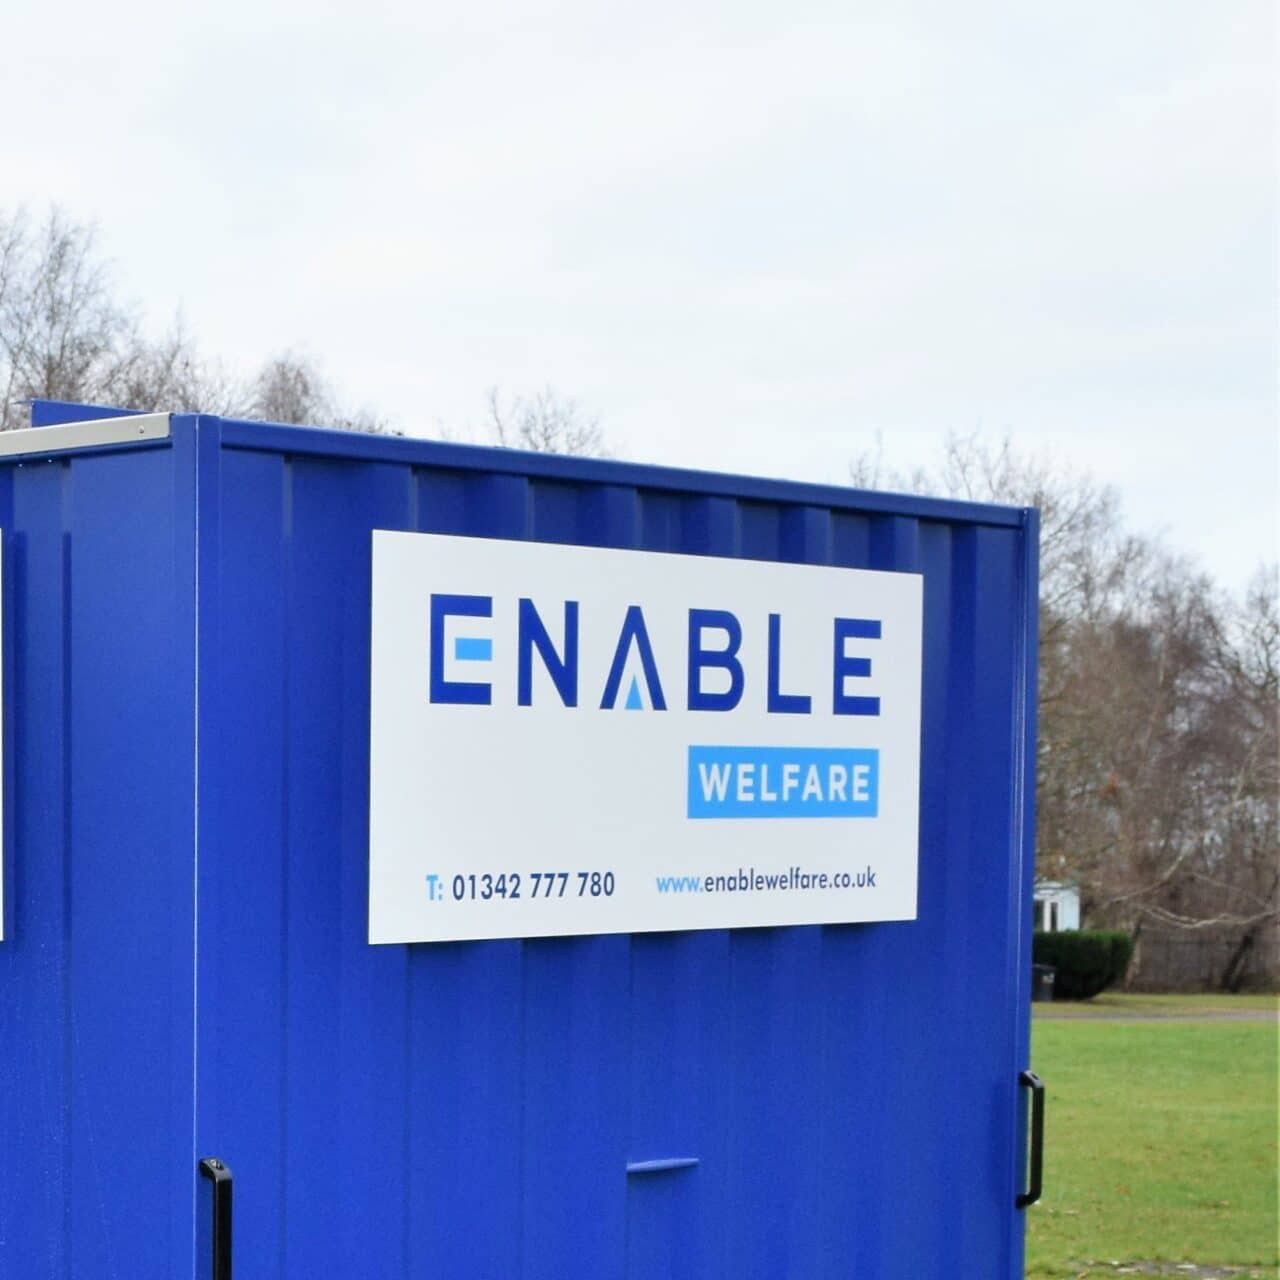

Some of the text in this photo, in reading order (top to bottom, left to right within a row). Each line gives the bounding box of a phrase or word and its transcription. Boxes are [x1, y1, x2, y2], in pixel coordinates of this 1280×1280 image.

[429, 593, 882, 716] ENABLE
[698, 762, 871, 802] WELFARE
[426, 872, 616, 900] T: 01342 777 780
[656, 865, 877, 892] www.enablewelfare.co.uk
